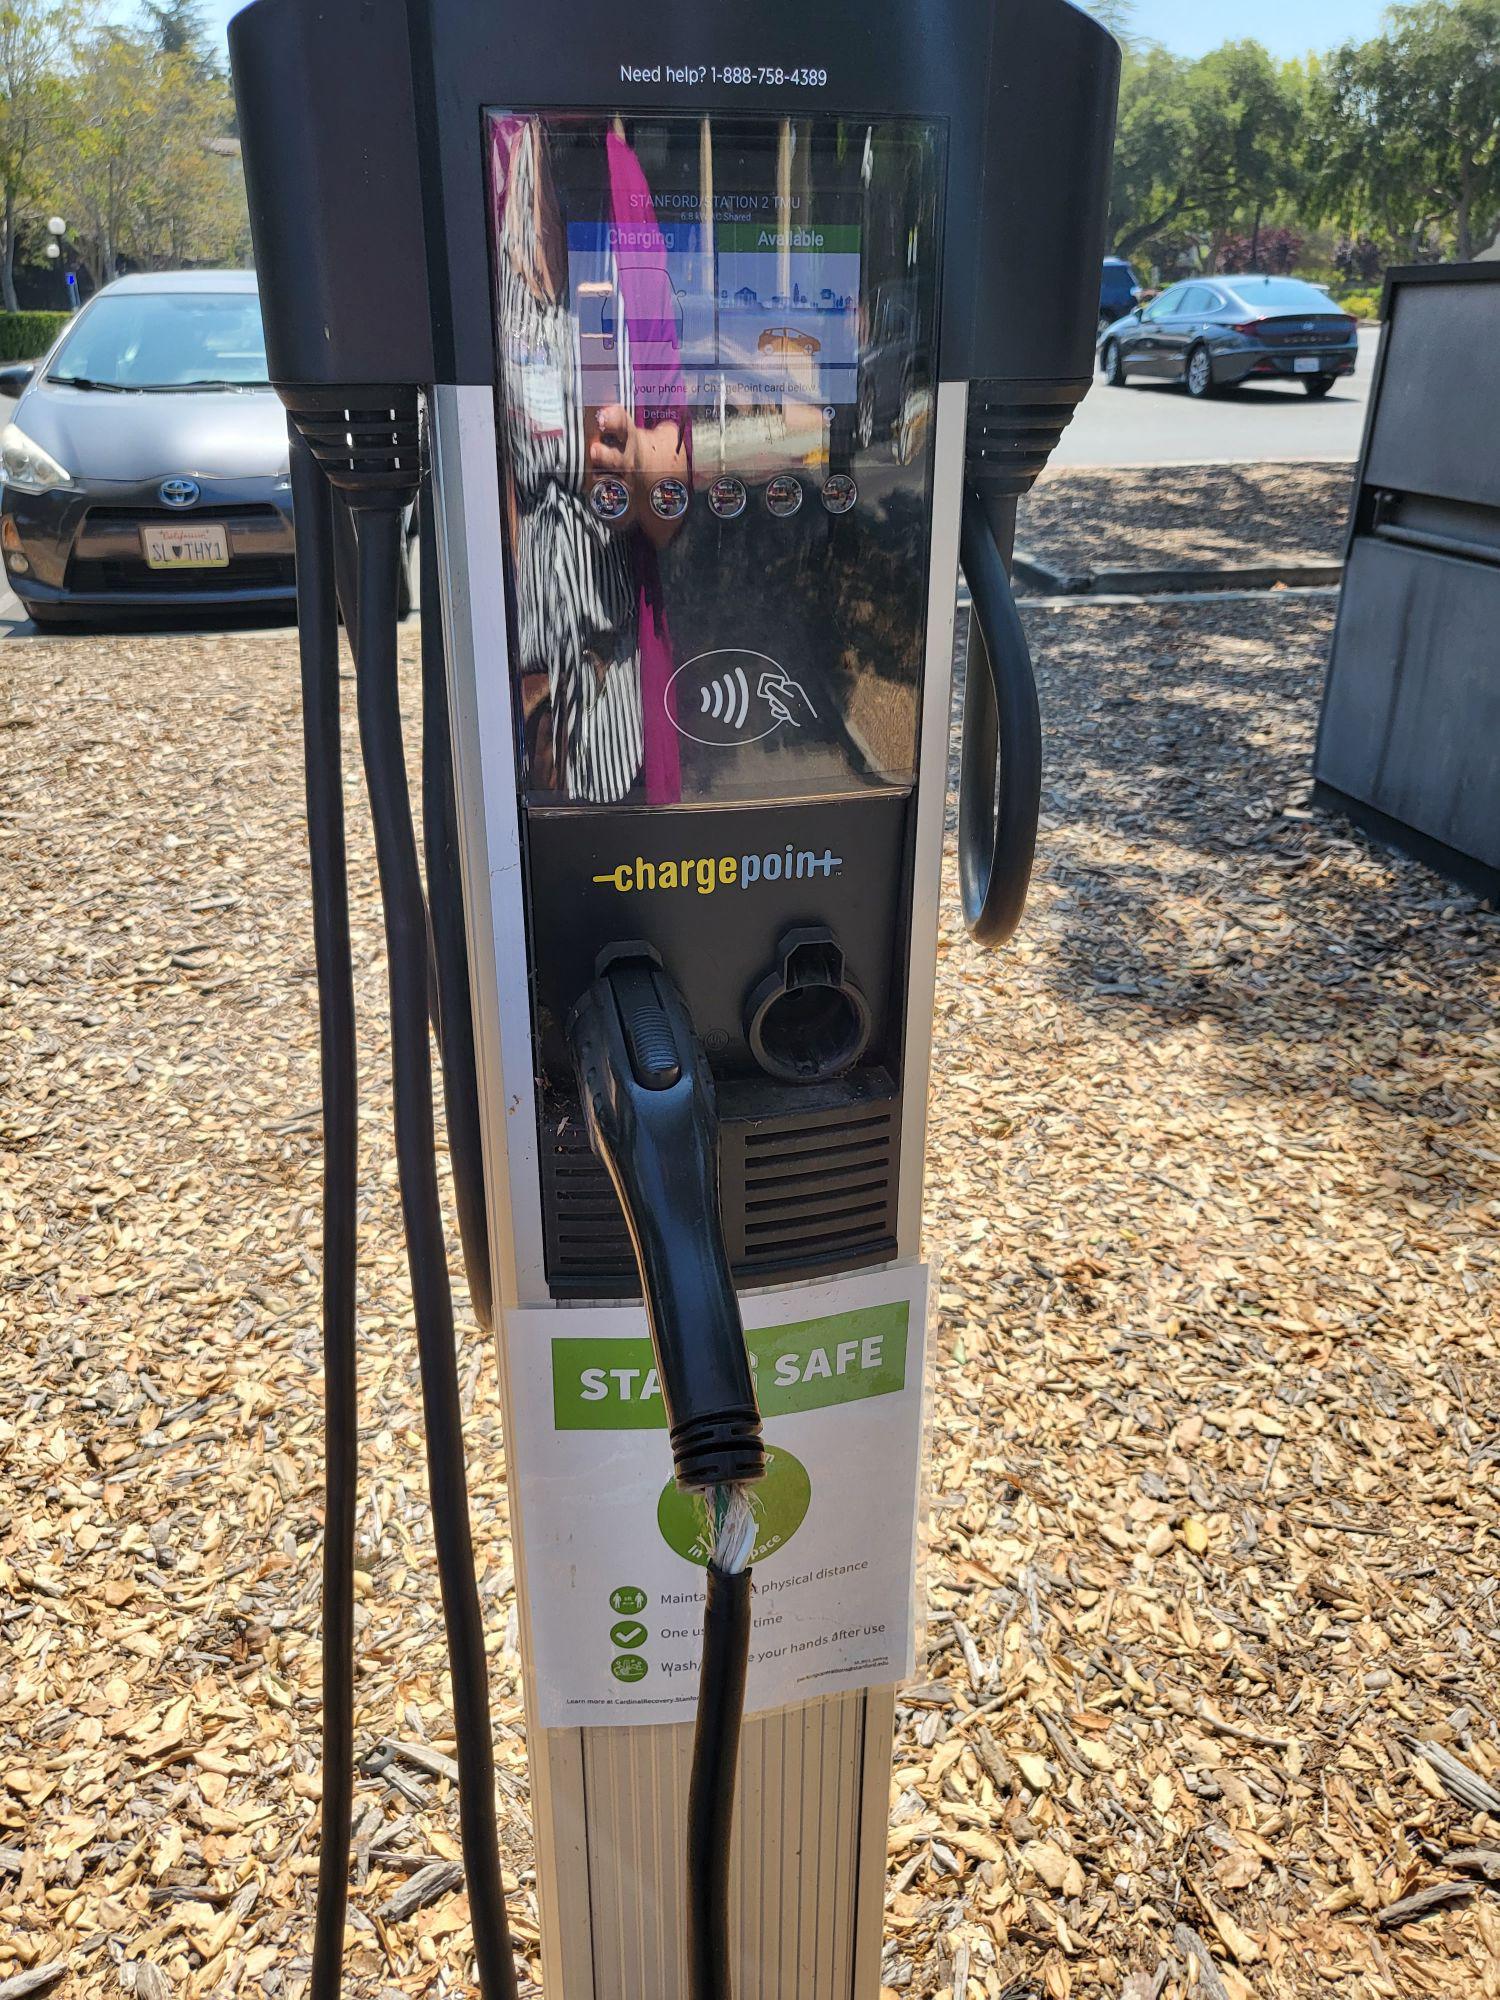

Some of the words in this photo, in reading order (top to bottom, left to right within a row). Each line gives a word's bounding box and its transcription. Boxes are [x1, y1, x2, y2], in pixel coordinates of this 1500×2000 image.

[620, 64, 660, 82] Need
[666, 65, 707, 86] help?
[711, 66, 827, 87] 1-888-758-4389
[762, 197, 769, 209] 2
[723, 212, 752, 222] Shared
[607, 229, 675, 249] Charging
[634, 384, 656, 396] your
[659, 384, 687, 396] phone
[691, 385, 700, 393] or
[703, 383, 762, 395] ChagePoint
[765, 383, 785, 393] card
[643, 409, 677, 420] Details
[774, 1334, 885, 1387] SAFE
[750, 1534, 782, 1560] pace
[660, 1592, 706, 1605] Mainta
[761, 1572, 814, 1595] physical
[815, 1560, 869, 1580] distance
[660, 1628, 689, 1639] One
[753, 1615, 784, 1629] time
[757, 1646, 788, 1663] your
[790, 1636, 829, 1654] hands
[831, 1629, 861, 1643] after
[863, 1623, 886, 1636] use
